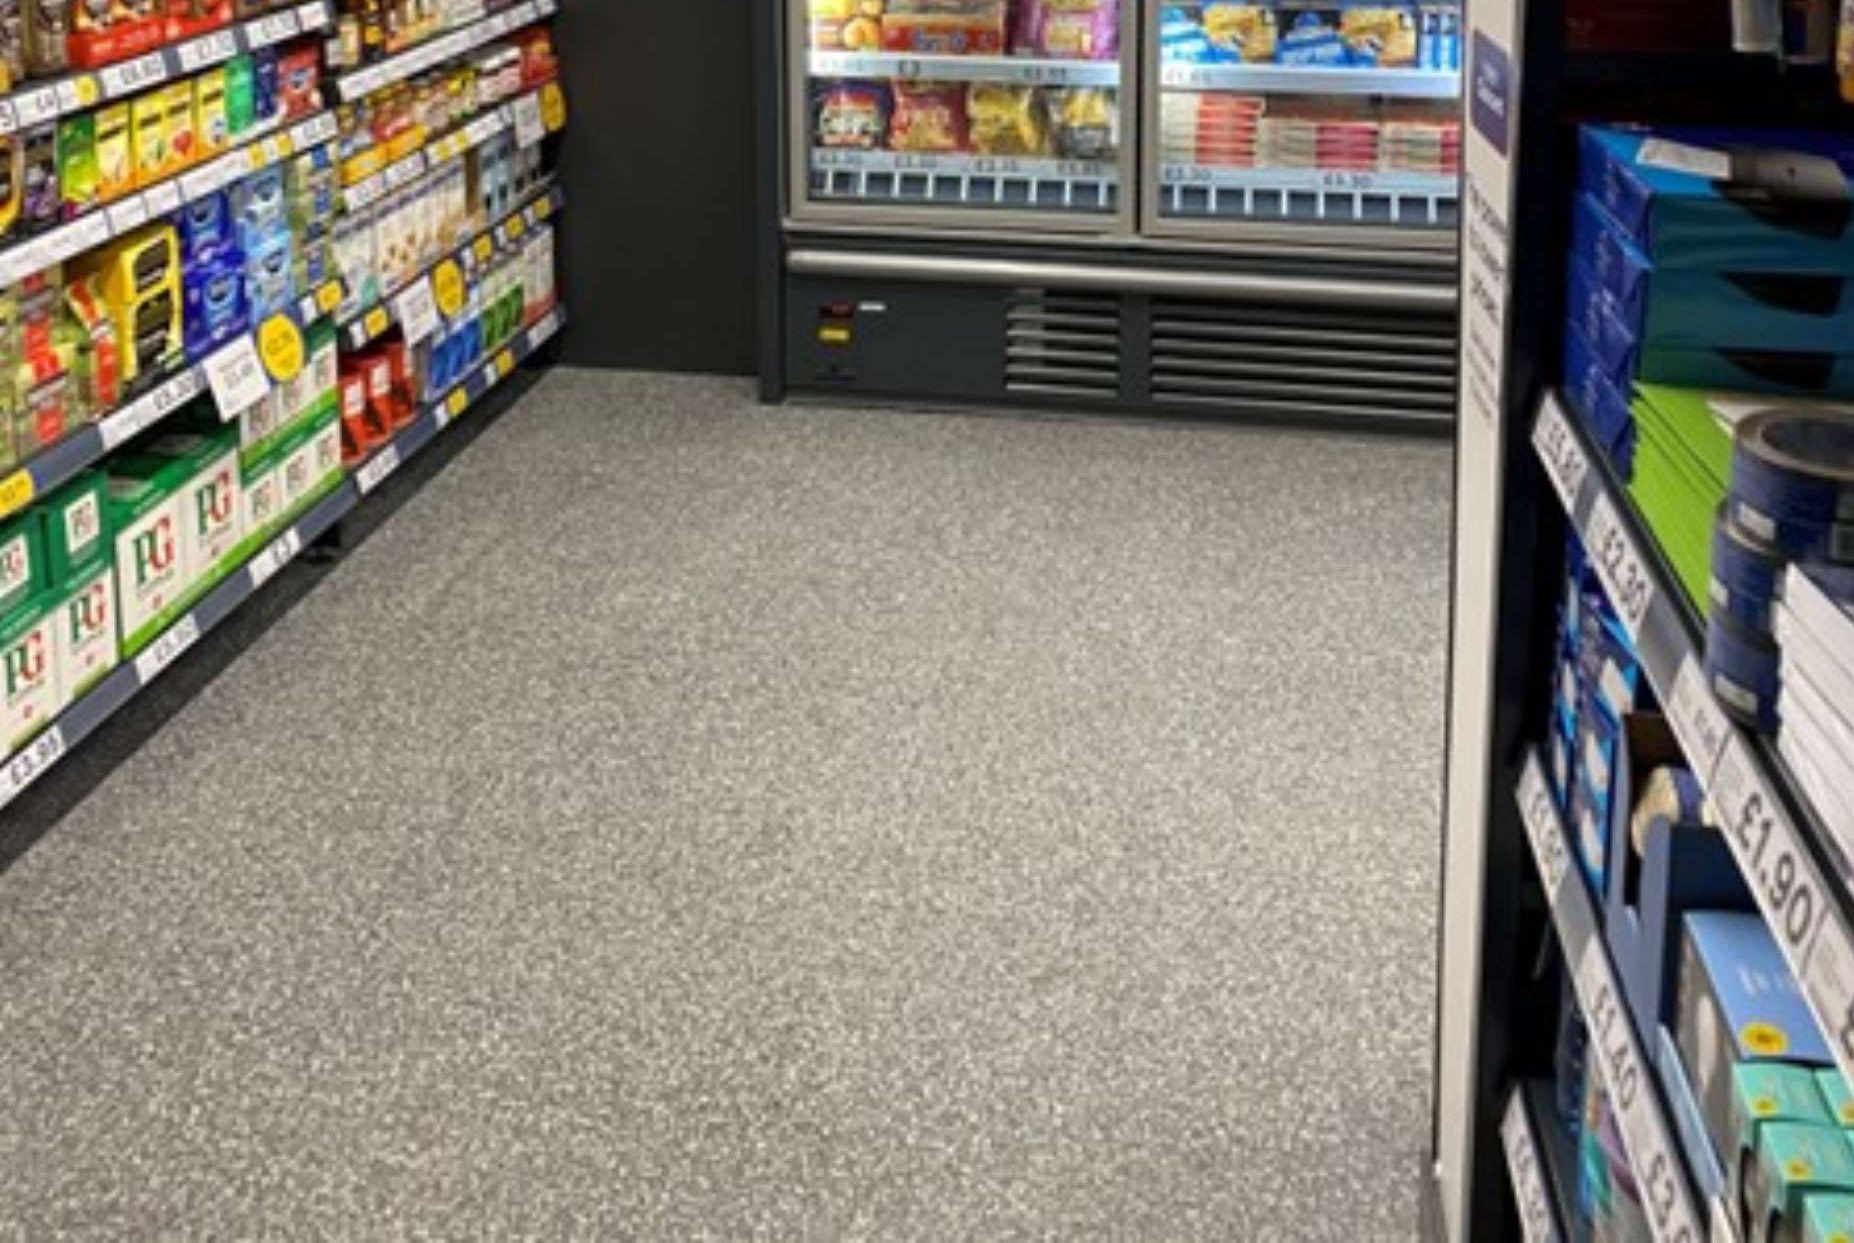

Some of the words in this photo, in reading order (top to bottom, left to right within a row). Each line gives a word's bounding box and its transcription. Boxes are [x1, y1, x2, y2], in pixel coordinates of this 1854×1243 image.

[196, 470, 234, 536] PG
[133, 514, 173, 585] PG
[69, 582, 105, 643] PG
[6, 630, 44, 696] PG
[1738, 792, 1812, 946] £1.90
